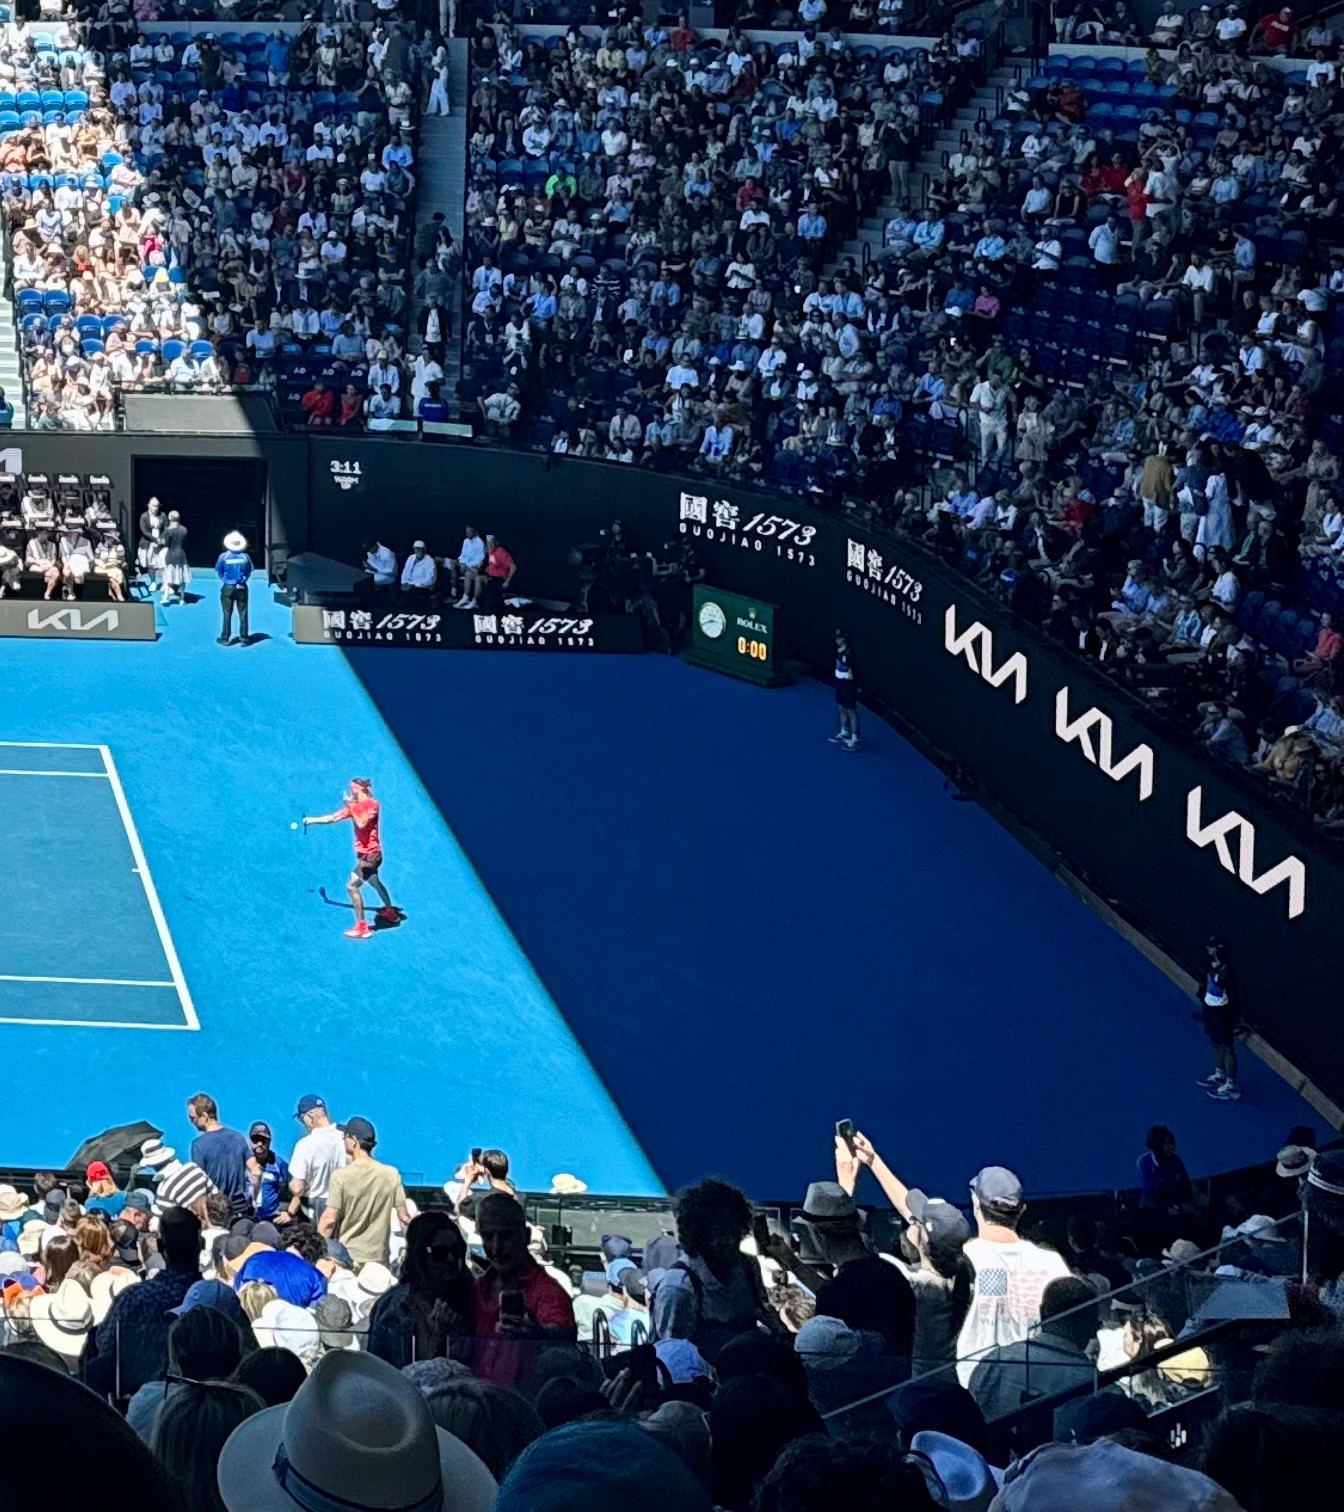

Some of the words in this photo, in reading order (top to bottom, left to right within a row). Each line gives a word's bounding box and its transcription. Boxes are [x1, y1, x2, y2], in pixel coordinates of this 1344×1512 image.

[330, 460, 362, 474] 3:11
[680, 522, 762, 552] GUOJIAO
[777, 546, 816, 567] 1573
[27, 608, 118, 632] KIA
[736, 618, 768, 634] ROLEX
[738, 636, 768, 661] 0:00
[944, 604, 1028, 705] KIA
[1056, 686, 1154, 802] KIA
[1186, 785, 1306, 921] KIA
